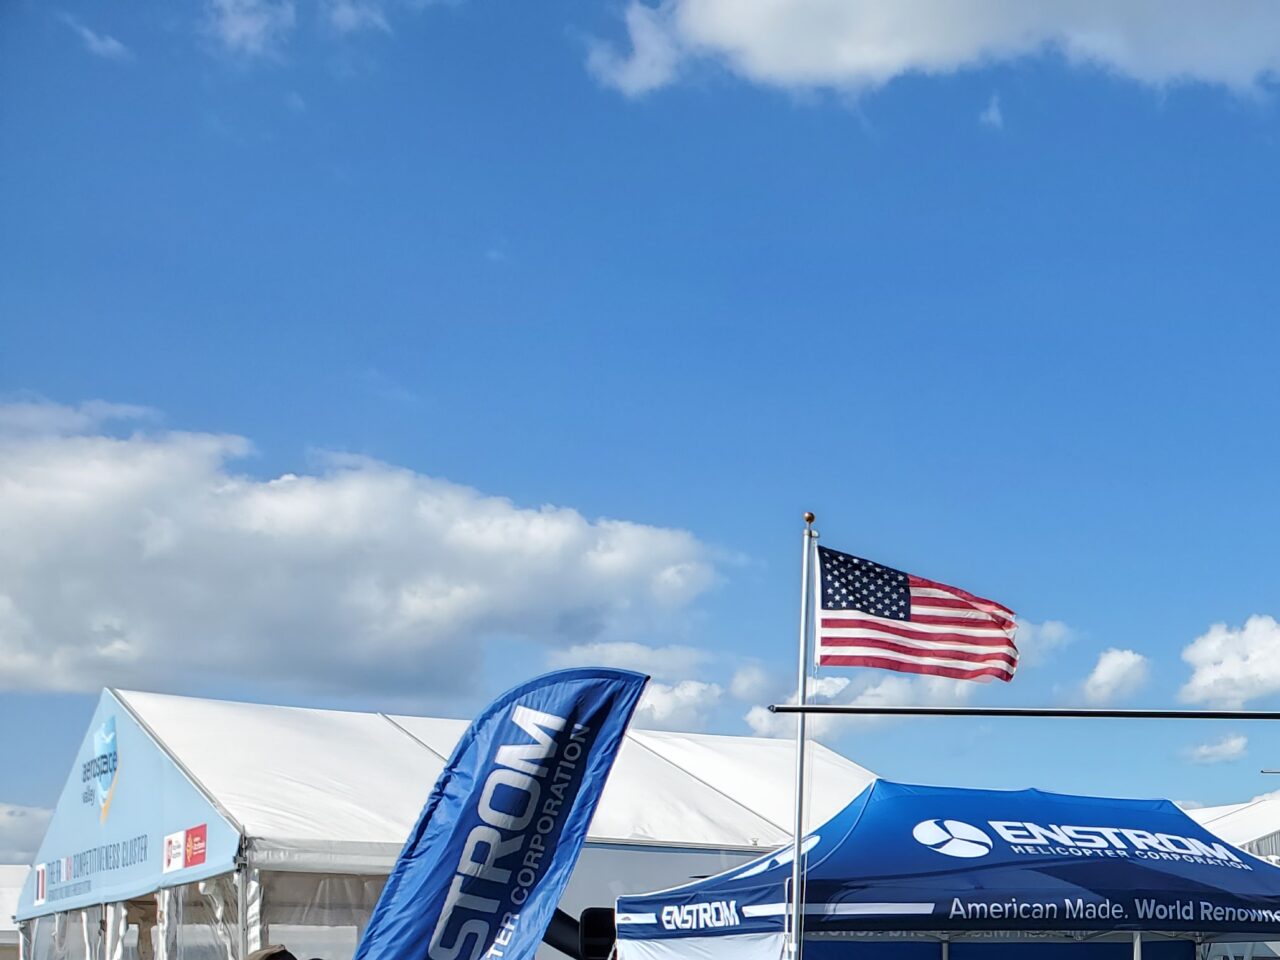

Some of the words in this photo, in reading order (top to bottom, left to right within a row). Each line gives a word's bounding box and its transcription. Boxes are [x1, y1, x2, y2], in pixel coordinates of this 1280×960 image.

[82, 752, 118, 782] aerospace
[511, 724, 590, 906] CORPORATION
[122, 834, 148, 867] CLUSTER
[988, 820, 1241, 863] ENSTROM
[1013, 845, 1130, 858] HELICOPTER
[1136, 850, 1253, 871] CORPORATION
[661, 900, 740, 930] ENSTROM
[949, 897, 1057, 919] American
[1064, 898, 1129, 919] Made.
[1134, 898, 1194, 920] World
